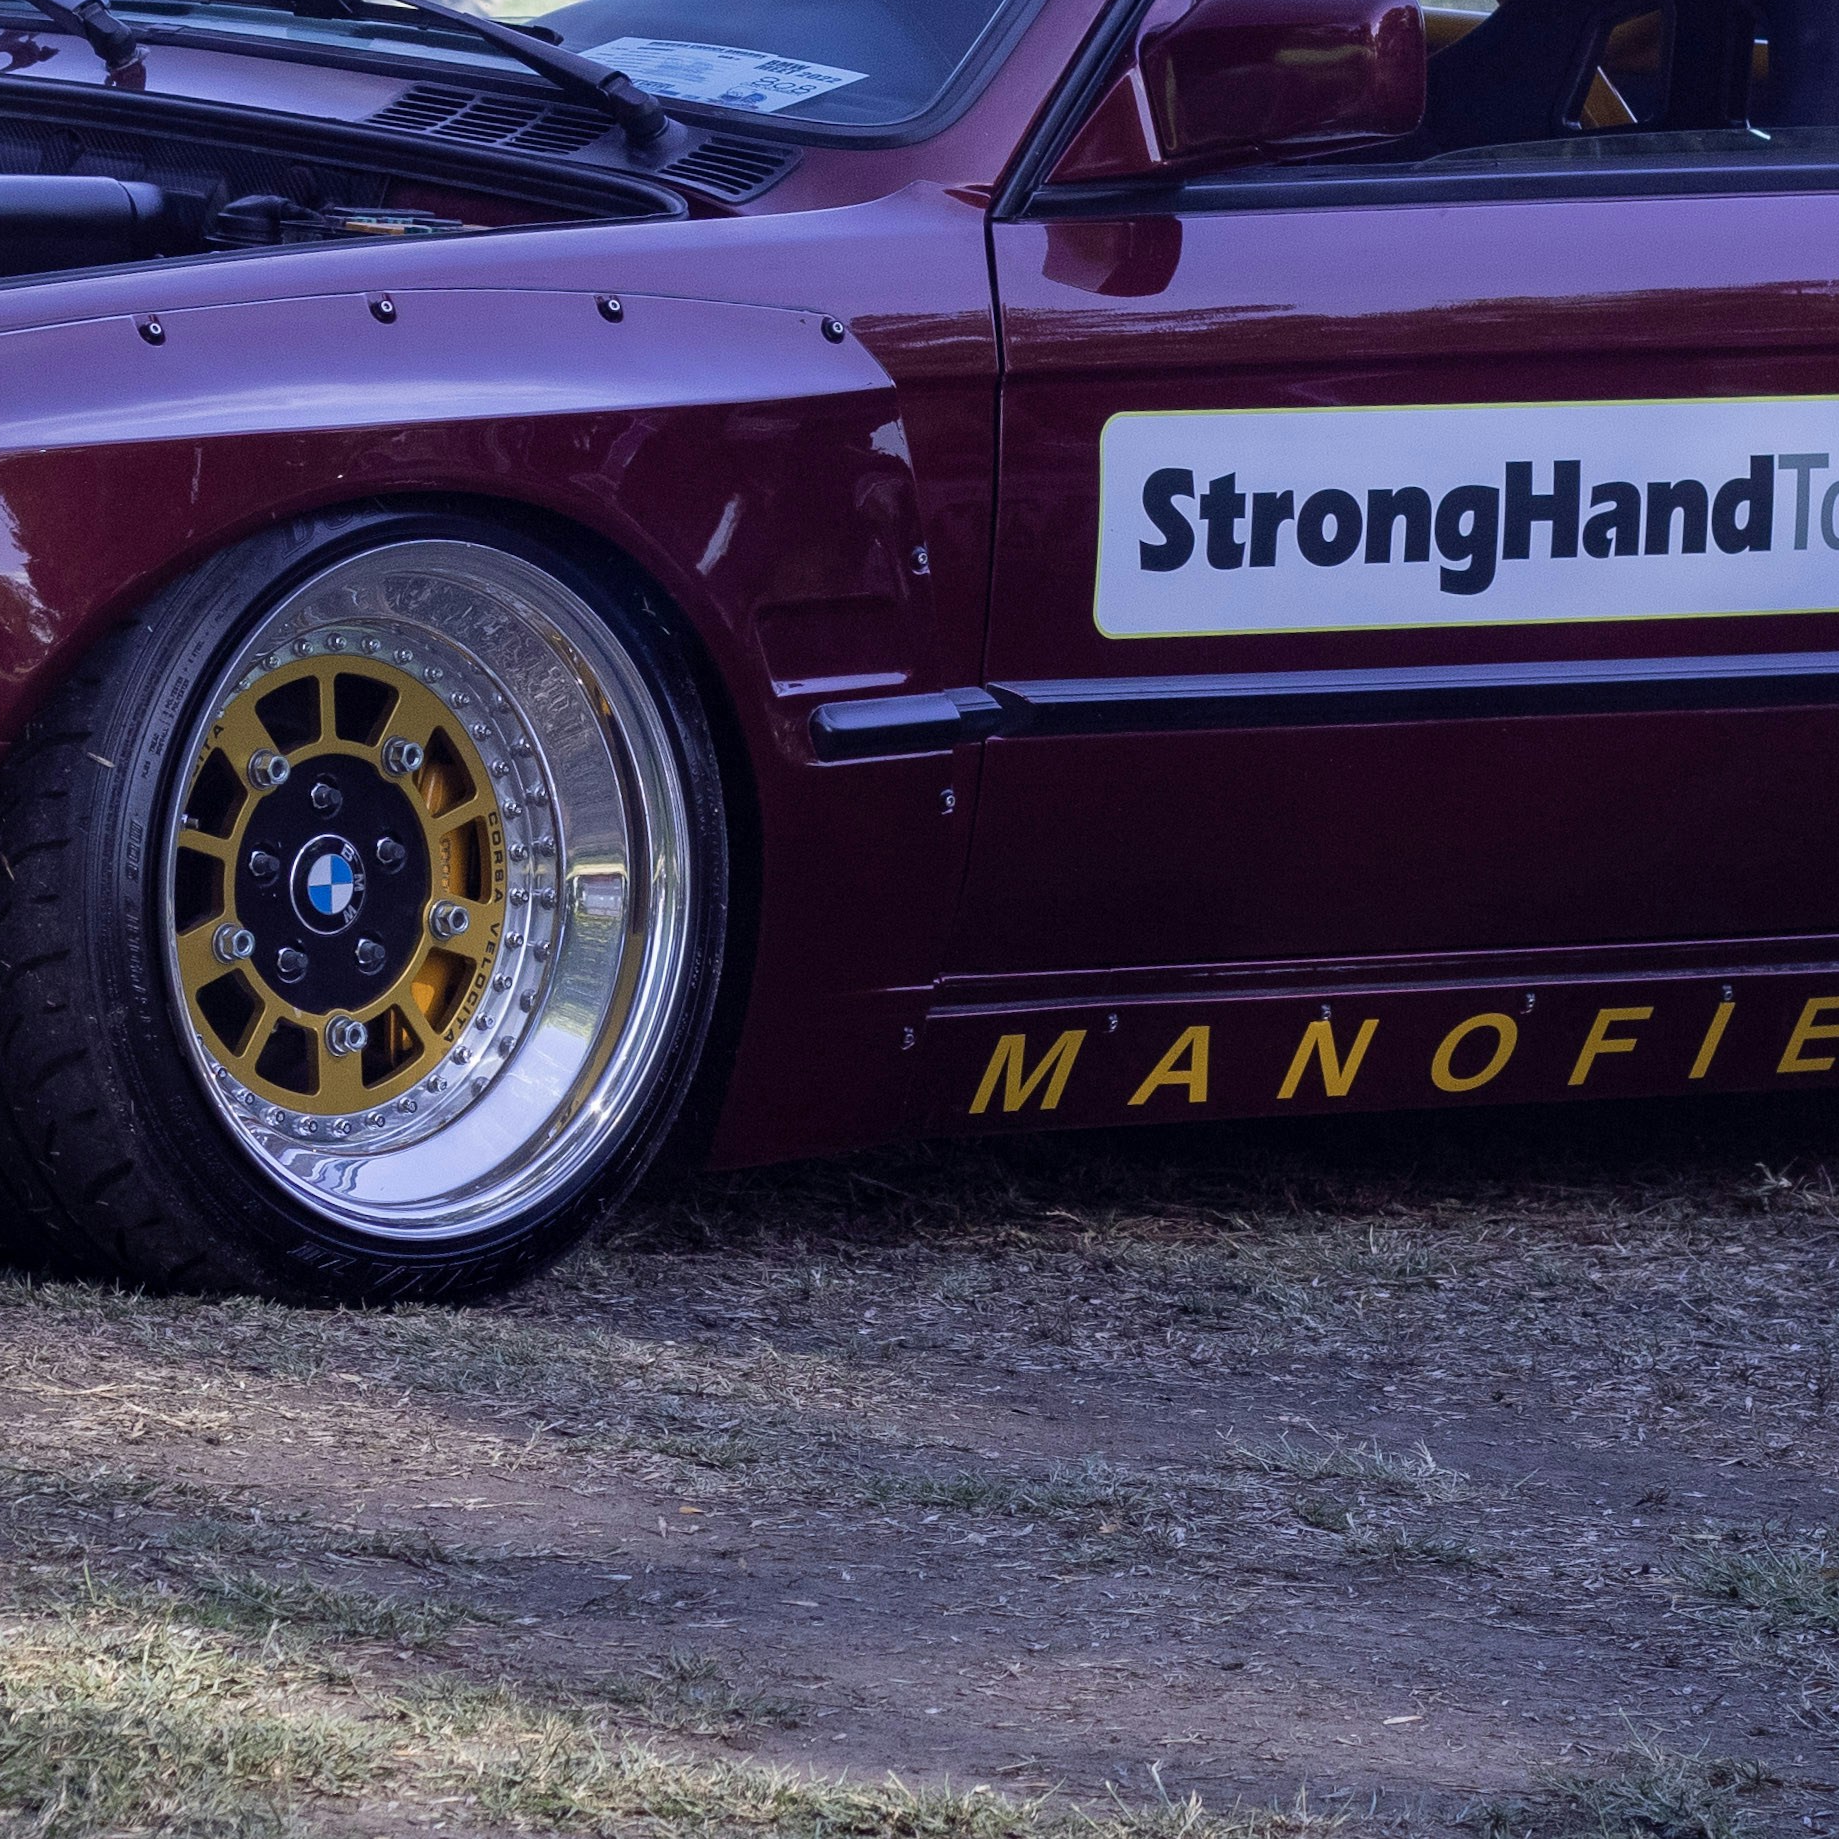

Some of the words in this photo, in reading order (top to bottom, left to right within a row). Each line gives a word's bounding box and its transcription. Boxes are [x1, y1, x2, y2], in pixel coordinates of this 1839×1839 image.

[765, 59, 812, 72] BMW
[796, 70, 843, 84] 2022
[341, 842, 366, 924] BMW
[487, 811, 505, 903] CORBA
[443, 921, 501, 1044] VELOCITA
